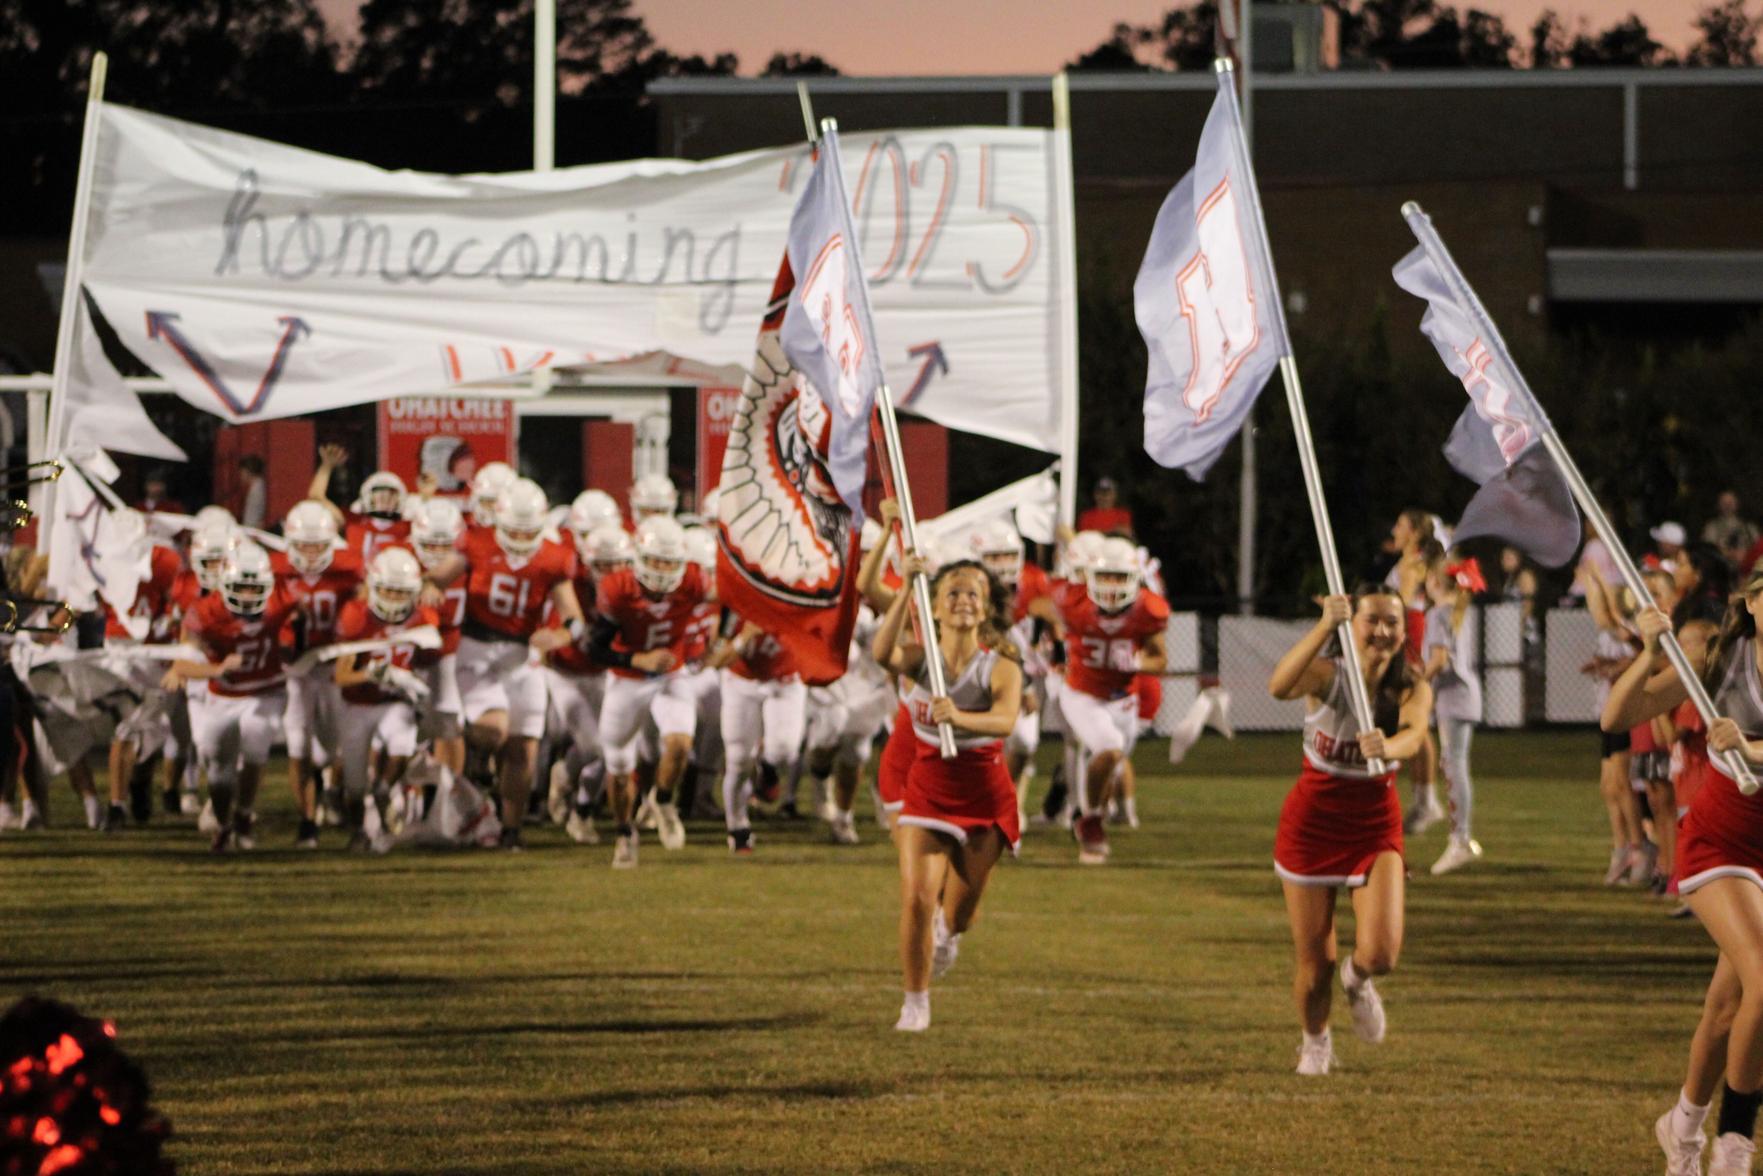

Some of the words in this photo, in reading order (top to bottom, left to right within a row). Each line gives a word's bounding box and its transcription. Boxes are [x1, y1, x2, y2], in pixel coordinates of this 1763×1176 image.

[213, 167, 742, 335] homecoming
[778, 135, 1042, 294] 025
[488, 572, 531, 618] 61
